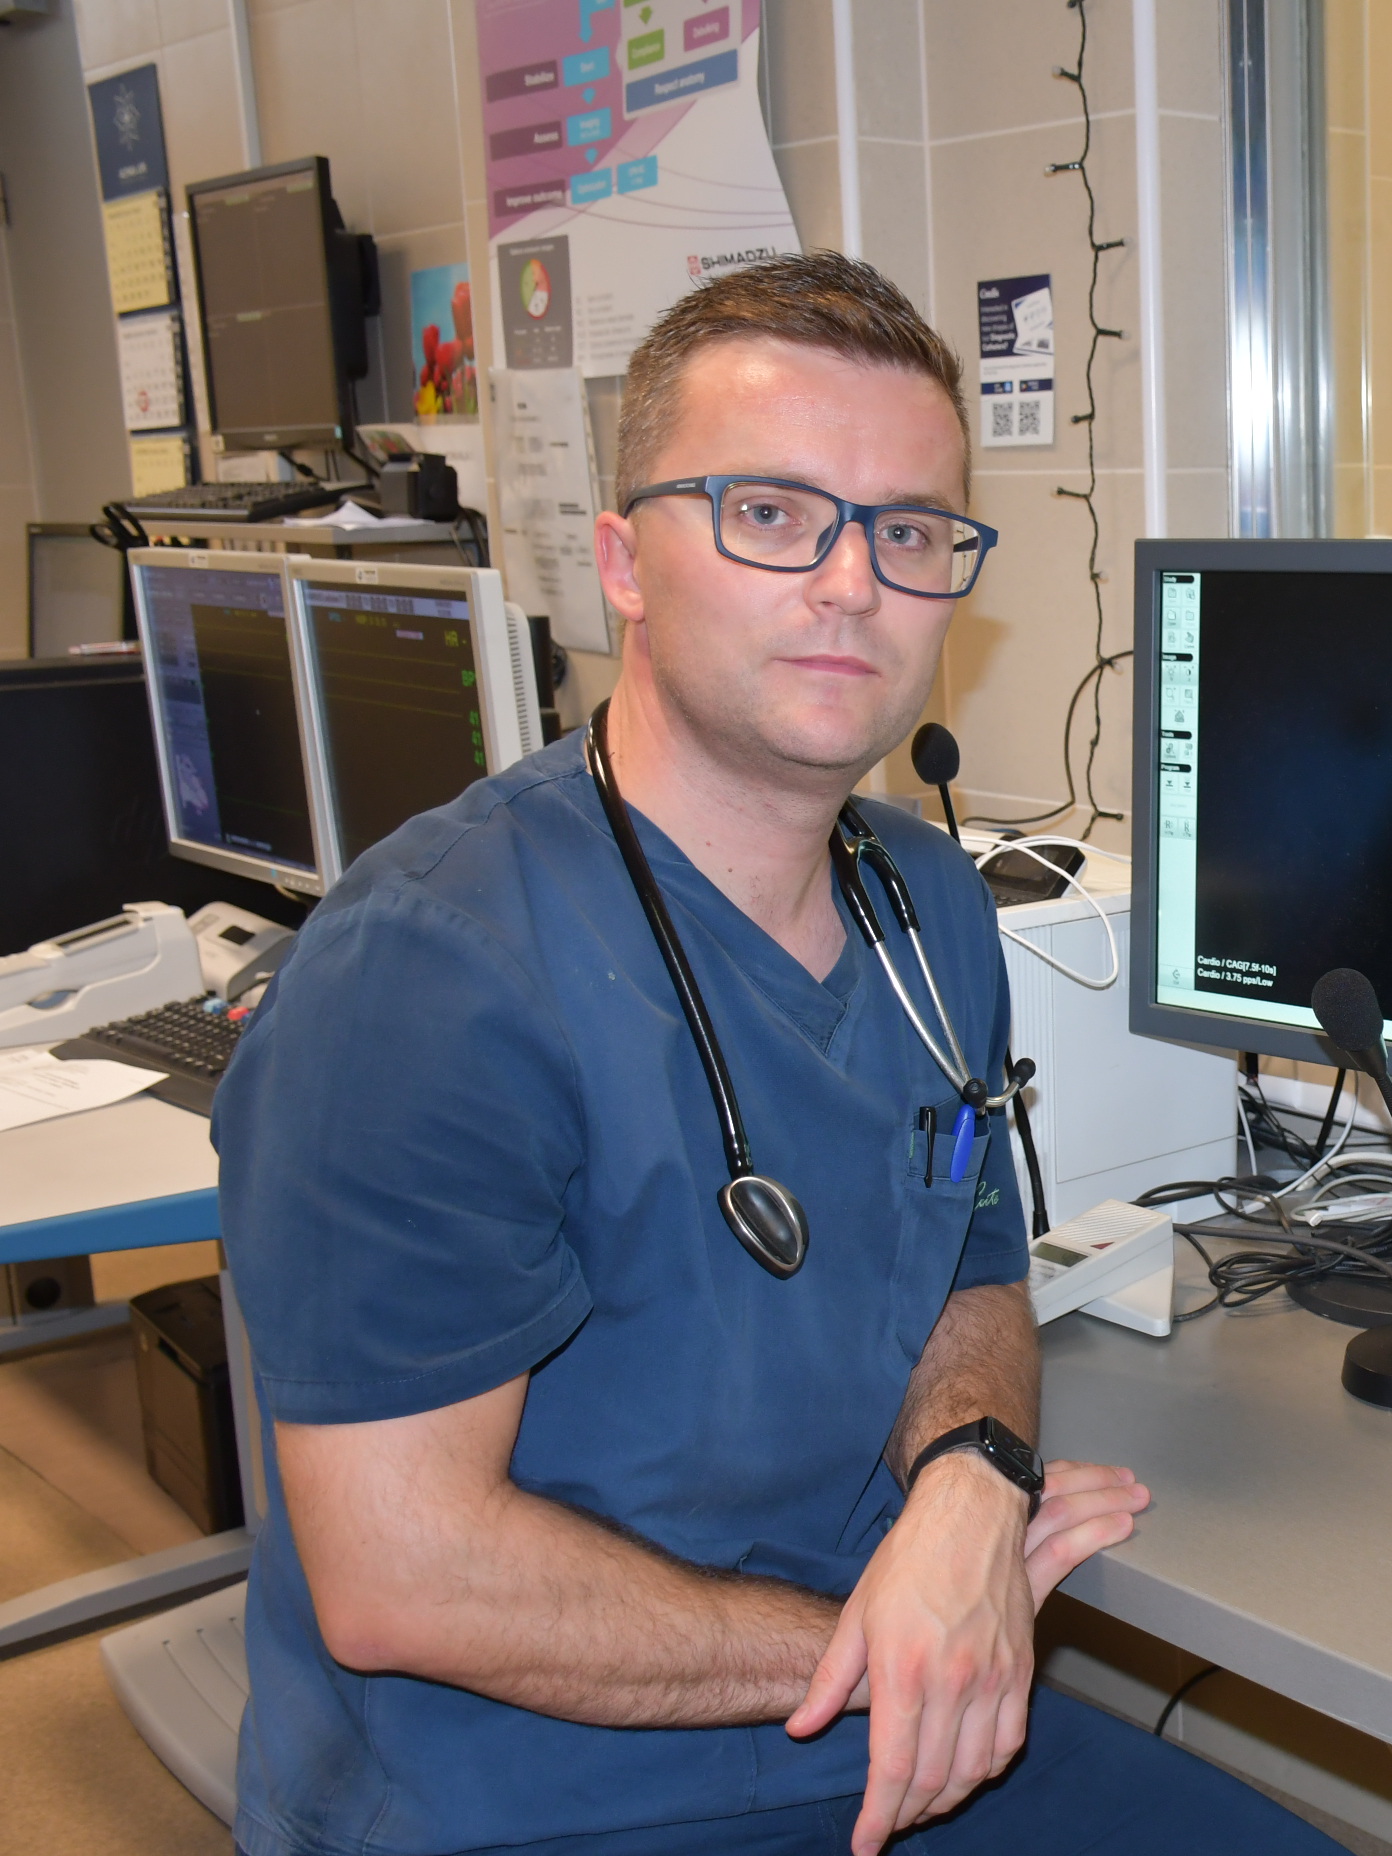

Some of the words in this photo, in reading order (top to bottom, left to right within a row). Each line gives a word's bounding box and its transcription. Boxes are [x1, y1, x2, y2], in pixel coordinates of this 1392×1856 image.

[700, 246, 777, 270] SHIMADZU
[1198, 955, 1220, 967] Cardio
[1197, 968, 1220, 979] Cardio
[1226, 973, 1242, 982] 3.75
